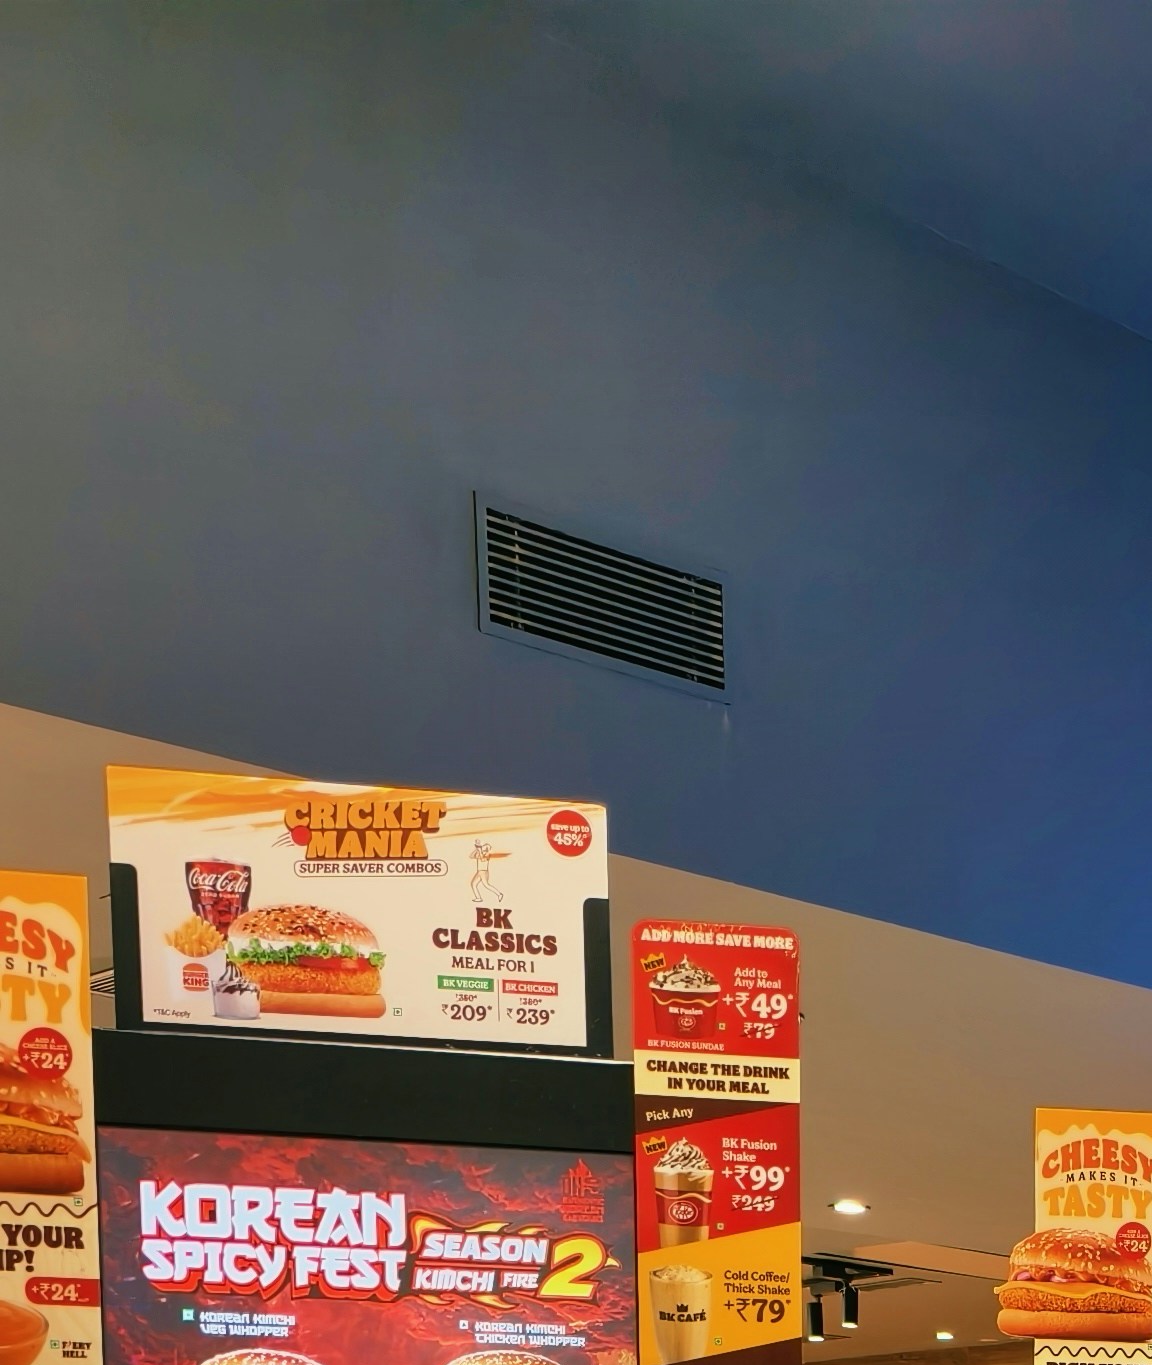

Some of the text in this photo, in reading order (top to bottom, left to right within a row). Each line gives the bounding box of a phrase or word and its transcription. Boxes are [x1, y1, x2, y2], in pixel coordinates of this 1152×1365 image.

[284, 801, 447, 834] CRICKET
[570, 825, 580, 834] up
[581, 825, 590, 833] to
[304, 830, 429, 860] MANIA
[299, 862, 442, 876] SUPER SAVER COMBOS
[475, 908, 513, 928] BK
[432, 928, 557, 955] CLASSICS
[641, 928, 794, 950] ADD MORE SAVE MORE
[451, 956, 525, 972] MEAL FOR
[644, 958, 664, 970] NEW
[734, 968, 768, 978] Add to
[183, 976, 209, 986] KING
[443, 979, 489, 989] BK VEGGIE
[505, 982, 556, 993] BK CHICKEN
[734, 978, 781, 990] Any Meal
[661, 1040, 690, 1050] FUSION
[692, 1041, 724, 1051] SUNDAE
[646, 1060, 790, 1080] CHANGE THE DRINK
[668, 1077, 769, 1094] IN YOUR MEAL
[646, 1108, 694, 1122] Pick Any
[646, 1140, 666, 1154] NEW
[722, 1138, 777, 1150] BK Fusion
[722, 1151, 756, 1162] Shake
[1066, 1171, 1138, 1186] MAKES IT
[1043, 1182, 1152, 1220] TASTY
[139, 1179, 406, 1246] KOREAN
[2, 1224, 84, 1249] YOUR
[141, 1239, 407, 1292] SPICY FEST
[422, 1233, 605, 1299] SEASON 2
[412, 1268, 539, 1292] KIMCHI FIRE
[724, 1270, 790, 1283] Cold Coffee/
[724, 1283, 791, 1296] Thick Shake
[659, 1309, 706, 1322] BK CAFÉ
[230, 1325, 289, 1338] WHOPPER
[529, 1335, 586, 1347] WHOPPER
